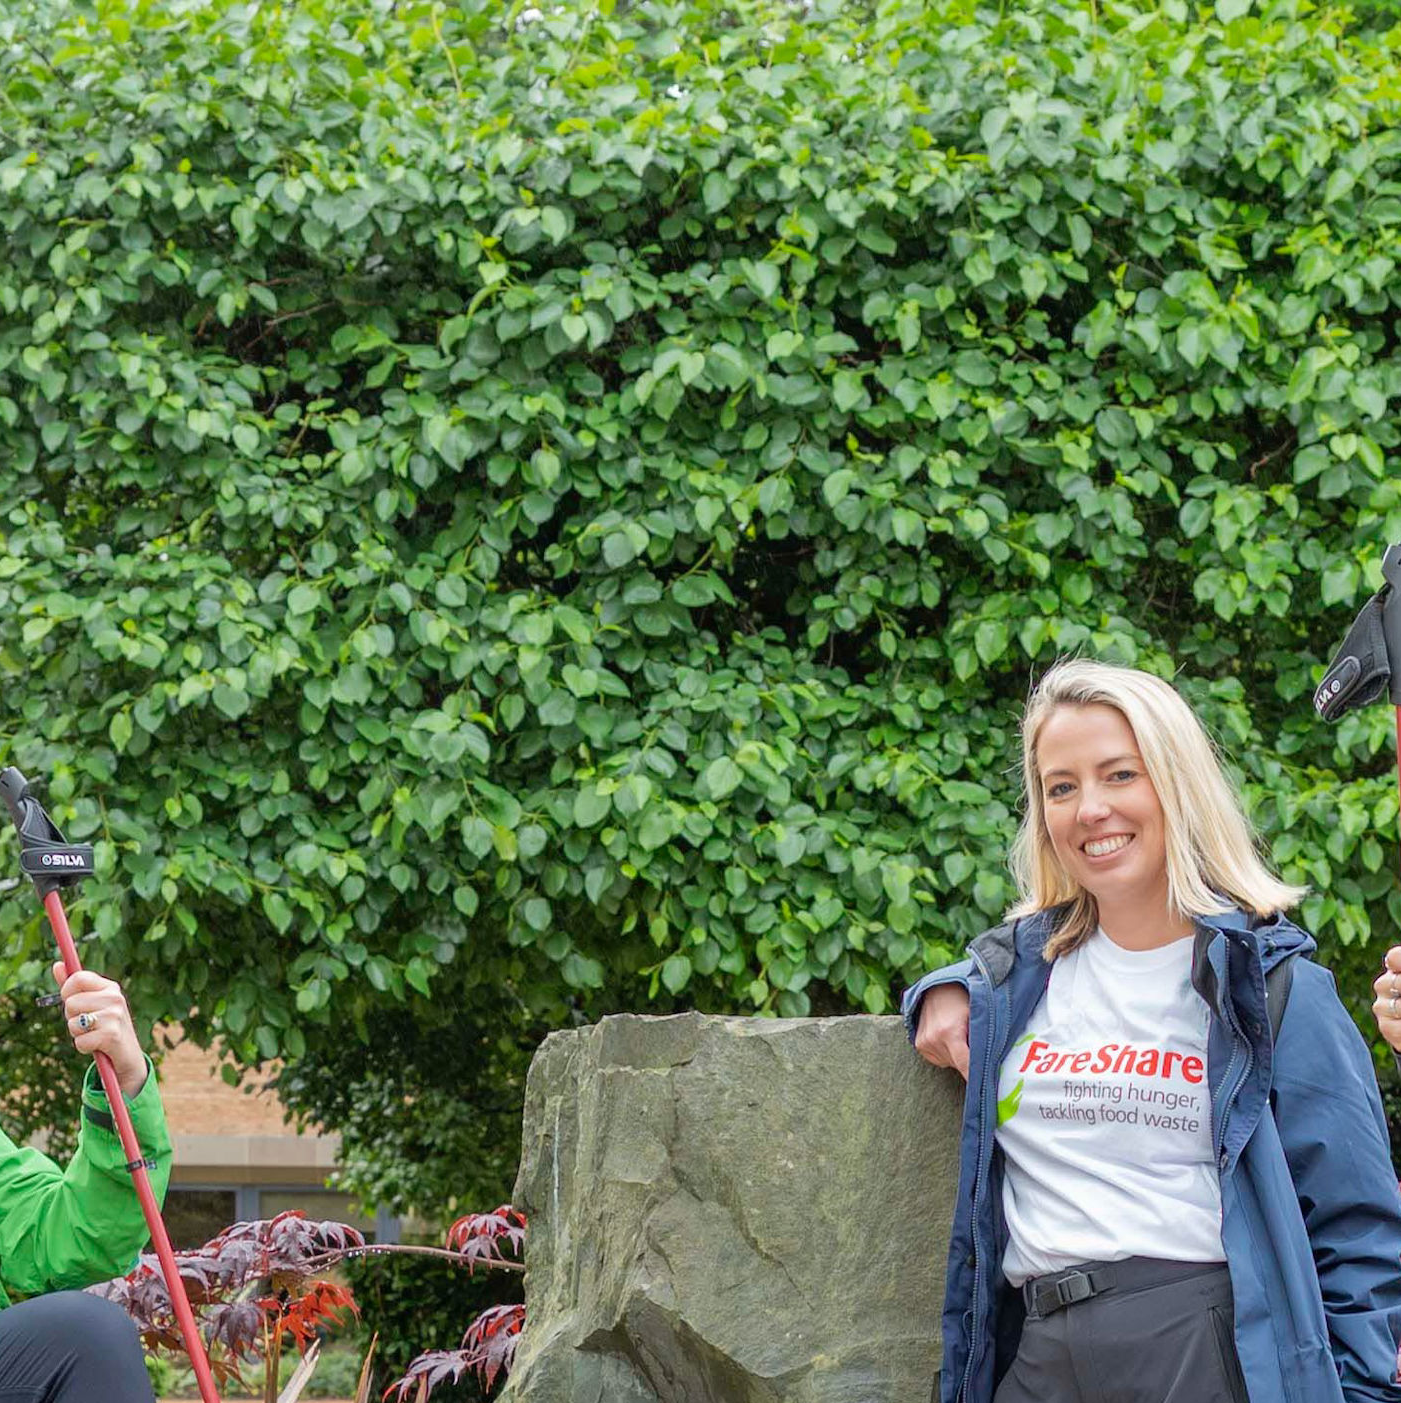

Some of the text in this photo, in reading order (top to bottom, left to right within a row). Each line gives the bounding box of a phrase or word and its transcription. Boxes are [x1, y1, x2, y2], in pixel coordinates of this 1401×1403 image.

[52, 855, 85, 866] SILVA
[1019, 1041, 1204, 1082] FareShare
[1064, 1080, 1200, 1112] fighting hunger,
[1039, 1103, 1199, 1132] tackling food waste
